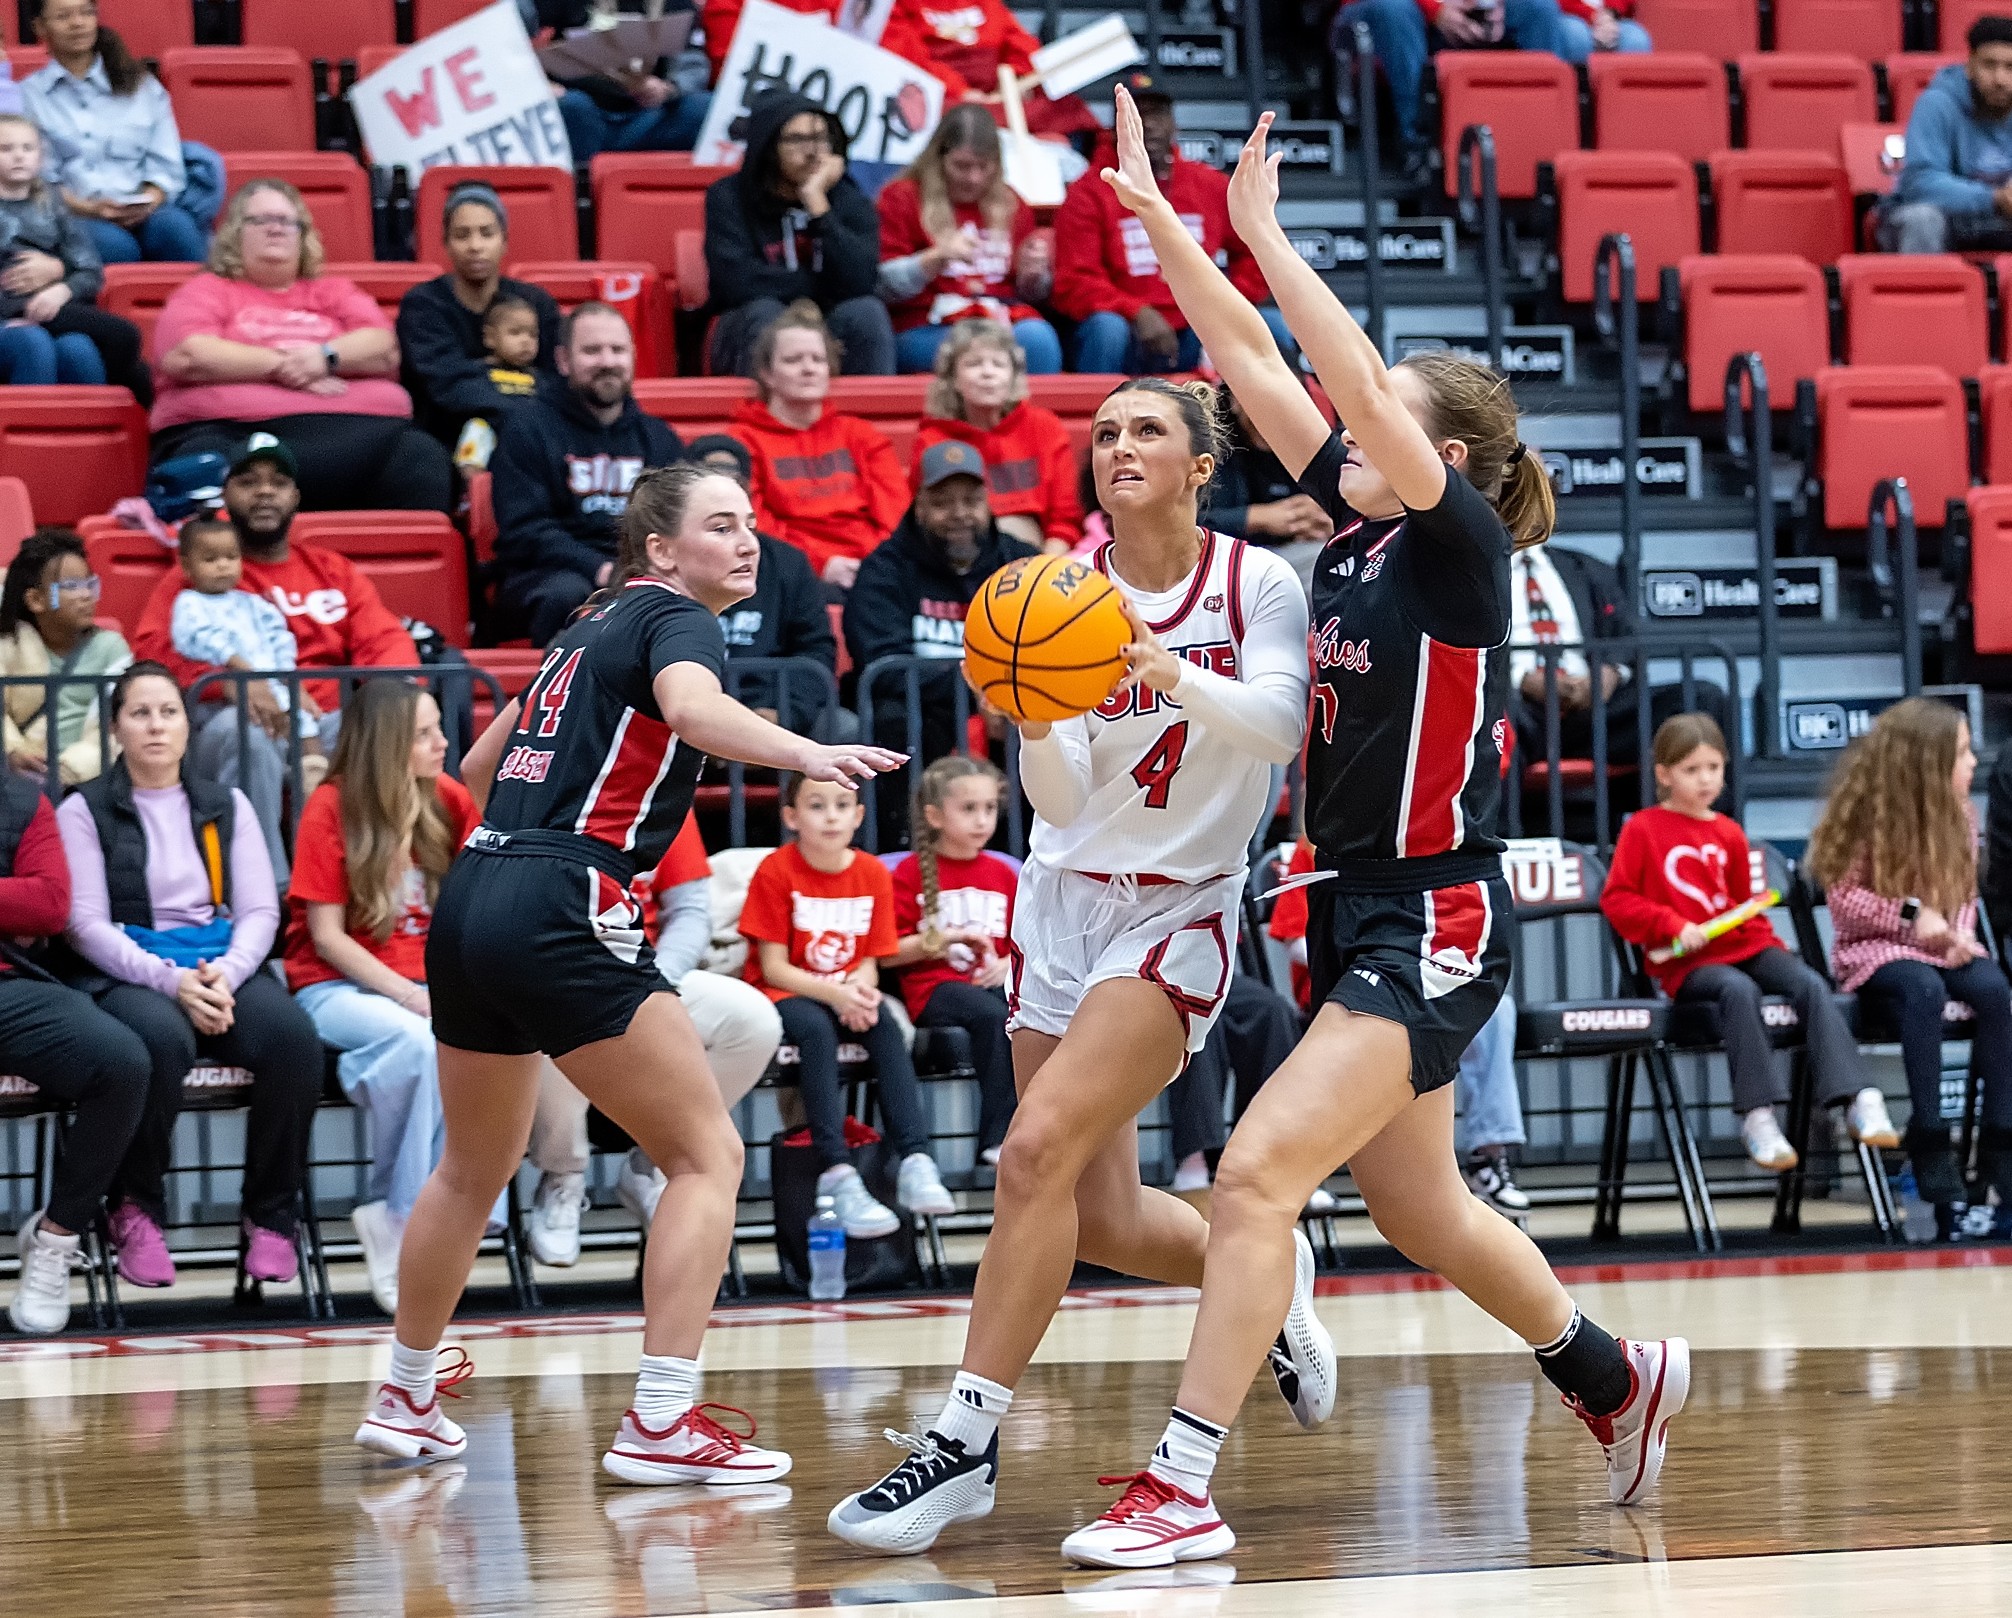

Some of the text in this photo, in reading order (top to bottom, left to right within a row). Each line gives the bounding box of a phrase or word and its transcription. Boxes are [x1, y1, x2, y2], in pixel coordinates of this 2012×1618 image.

[384, 46, 497, 139] WE
[1129, 719, 1189, 810] 4
[1502, 852, 1584, 903] UE
[1562, 1008, 1651, 1031] COUGARS
